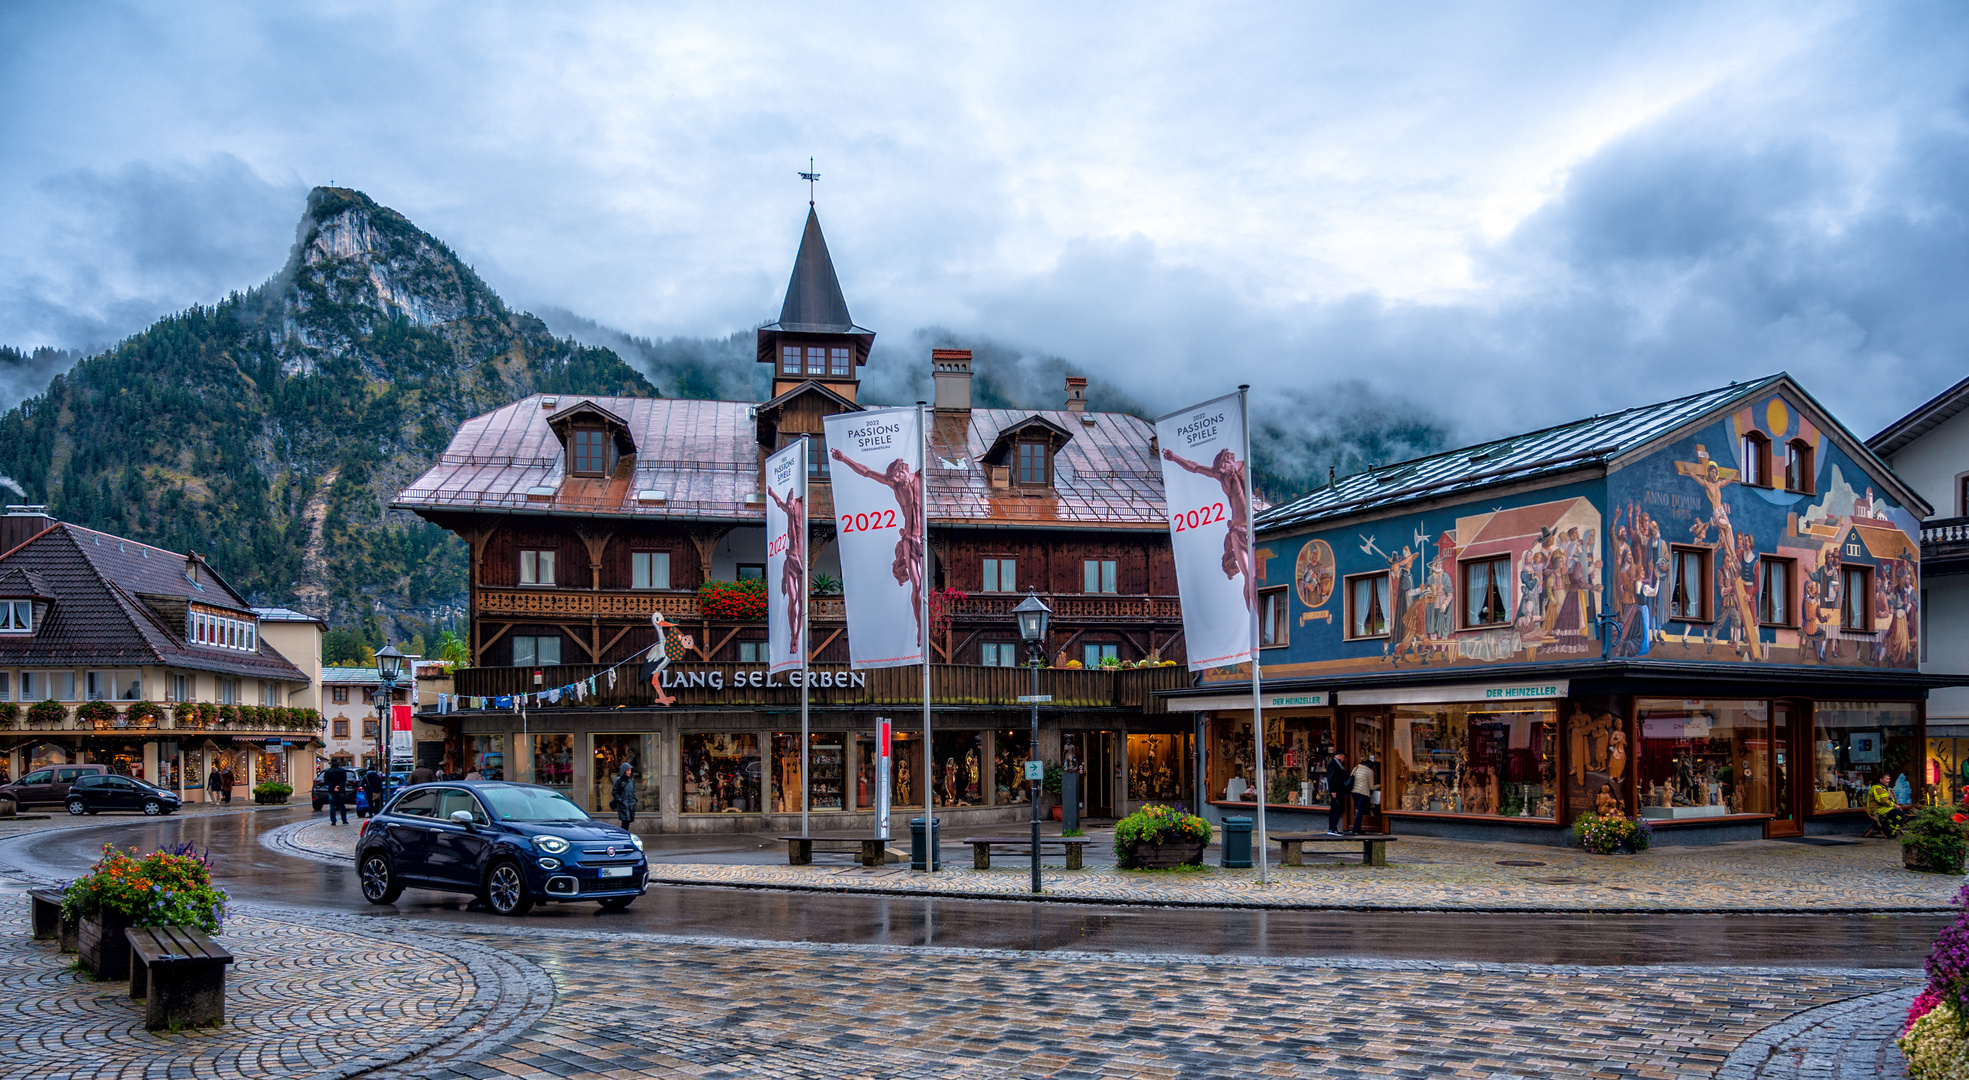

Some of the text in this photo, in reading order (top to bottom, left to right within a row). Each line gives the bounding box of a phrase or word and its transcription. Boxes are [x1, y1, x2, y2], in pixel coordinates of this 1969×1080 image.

[1177, 413, 1224, 436] PASSIONS
[1193, 413, 1206, 421] 2022
[848, 424, 900, 438] PASSIONS
[1186, 426, 1218, 443] SPIELE
[858, 435, 892, 447] SPIELE
[1644, 490, 1701, 510] ANNO DOMINI
[841, 509, 897, 533] 2022
[1174, 502, 1226, 533] 2022
[661, 669, 866, 691] LANG SEL. ERBEN
[1486, 689, 1503, 698] DER
[1505, 686, 1557, 697] HEINZELLER
[1272, 696, 1321, 706] DER HEINZELLER
